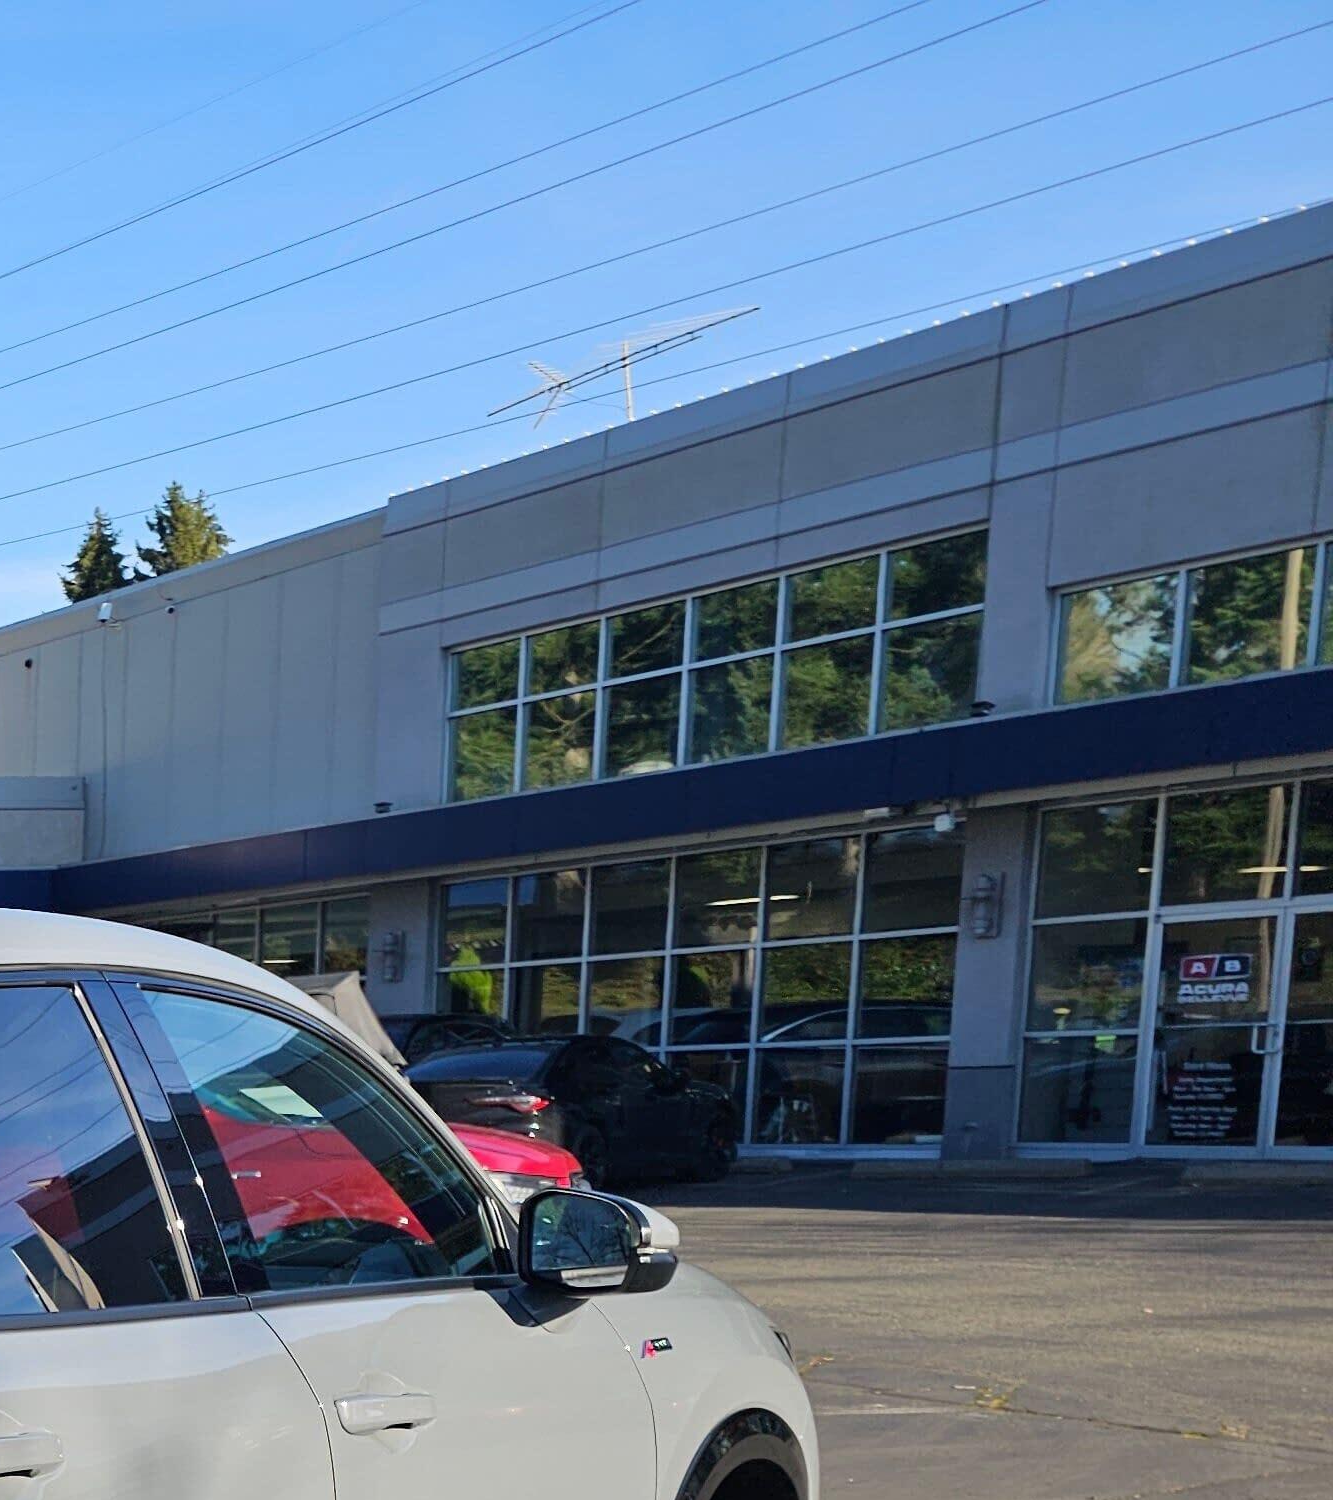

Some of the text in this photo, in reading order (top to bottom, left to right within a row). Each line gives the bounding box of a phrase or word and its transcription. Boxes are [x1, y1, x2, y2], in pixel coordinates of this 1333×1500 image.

[1190, 959, 1242, 975] A B
[1177, 982, 1250, 996] ACURA
